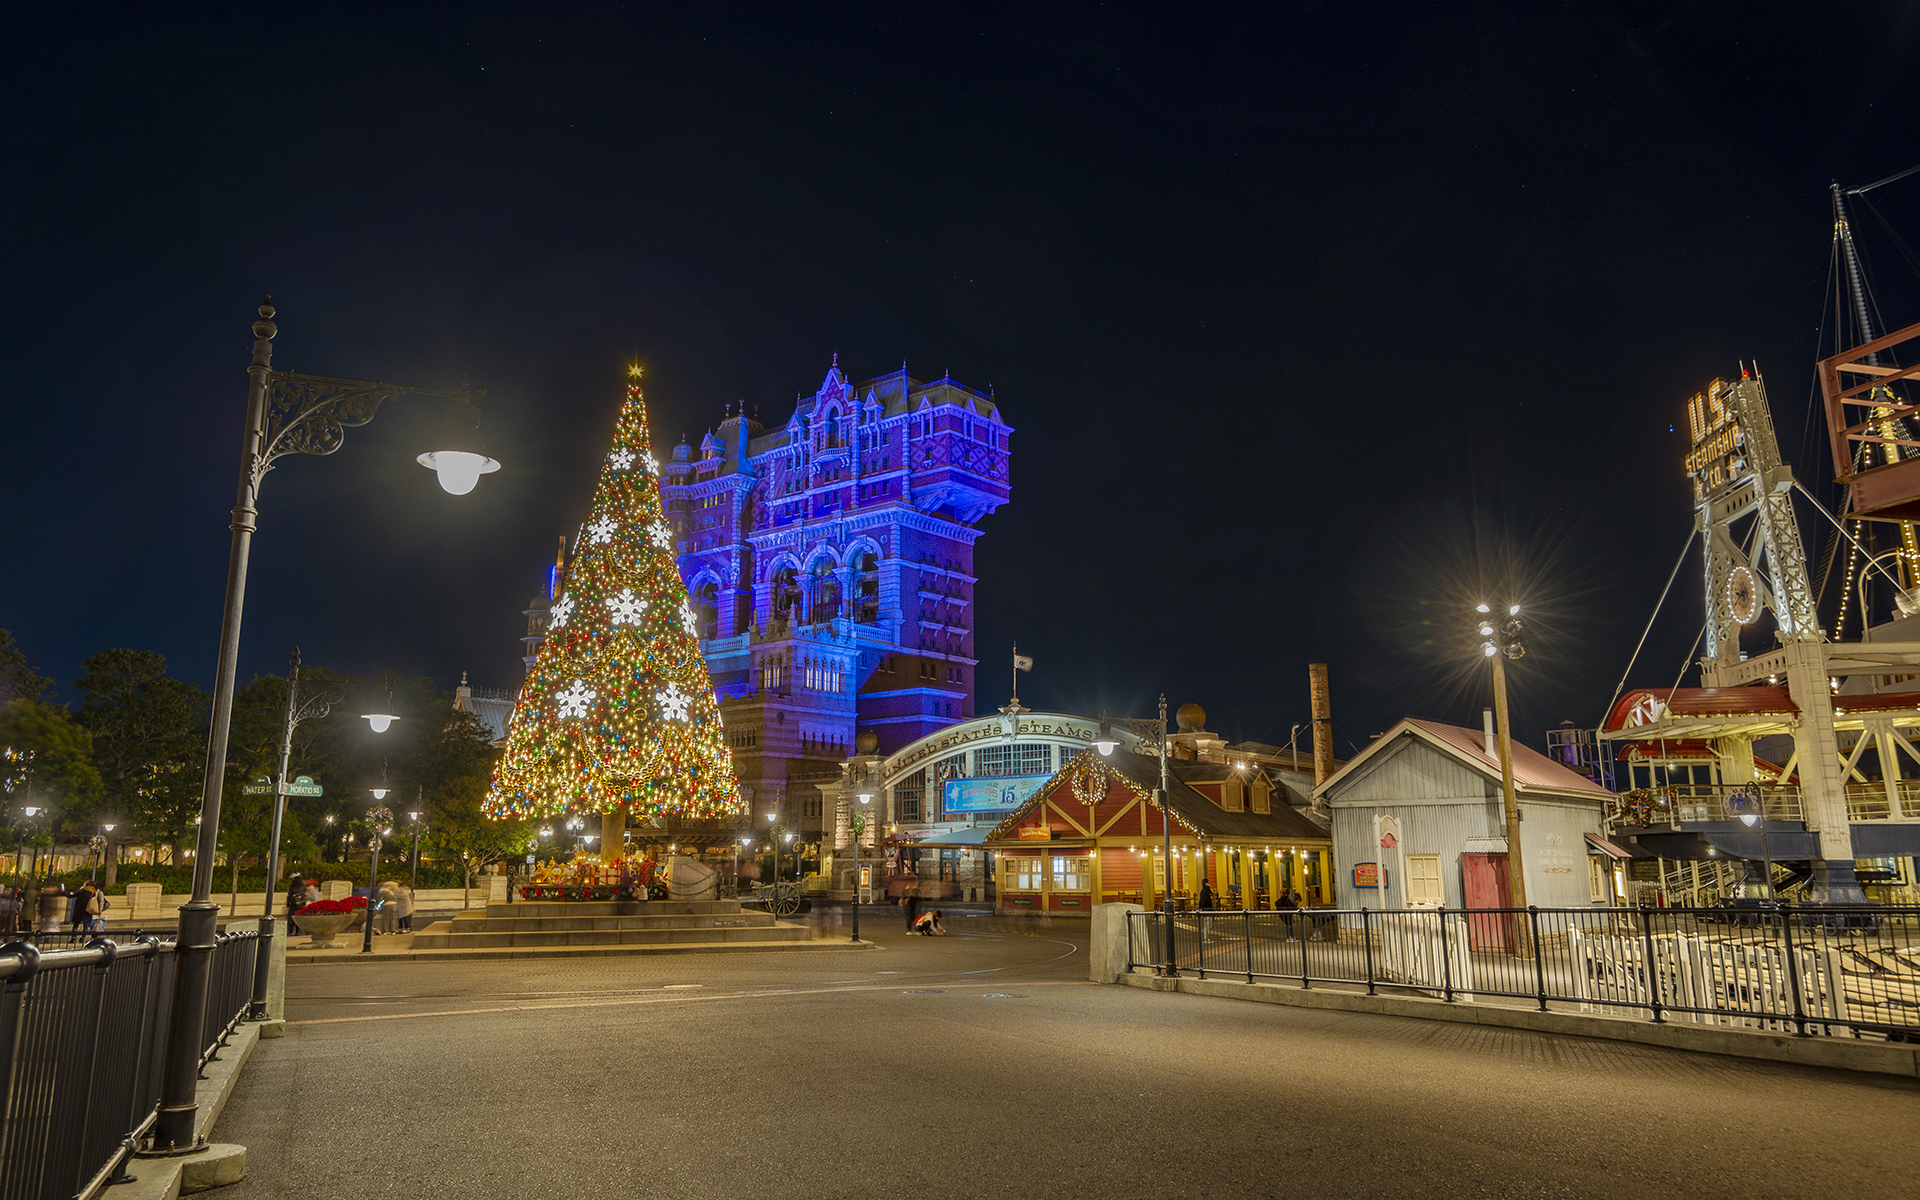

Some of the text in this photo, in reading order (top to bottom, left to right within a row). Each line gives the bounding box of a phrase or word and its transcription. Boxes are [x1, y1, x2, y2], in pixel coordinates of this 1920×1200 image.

[1688, 377, 1733, 444] U.S.
[1685, 421, 1740, 477] STEAMSHIP
[882, 744, 937, 779] UNITED
[941, 726, 1002, 748] STATES
[245, 786, 265, 794] WATER
[290, 785, 313, 795] HORATIO
